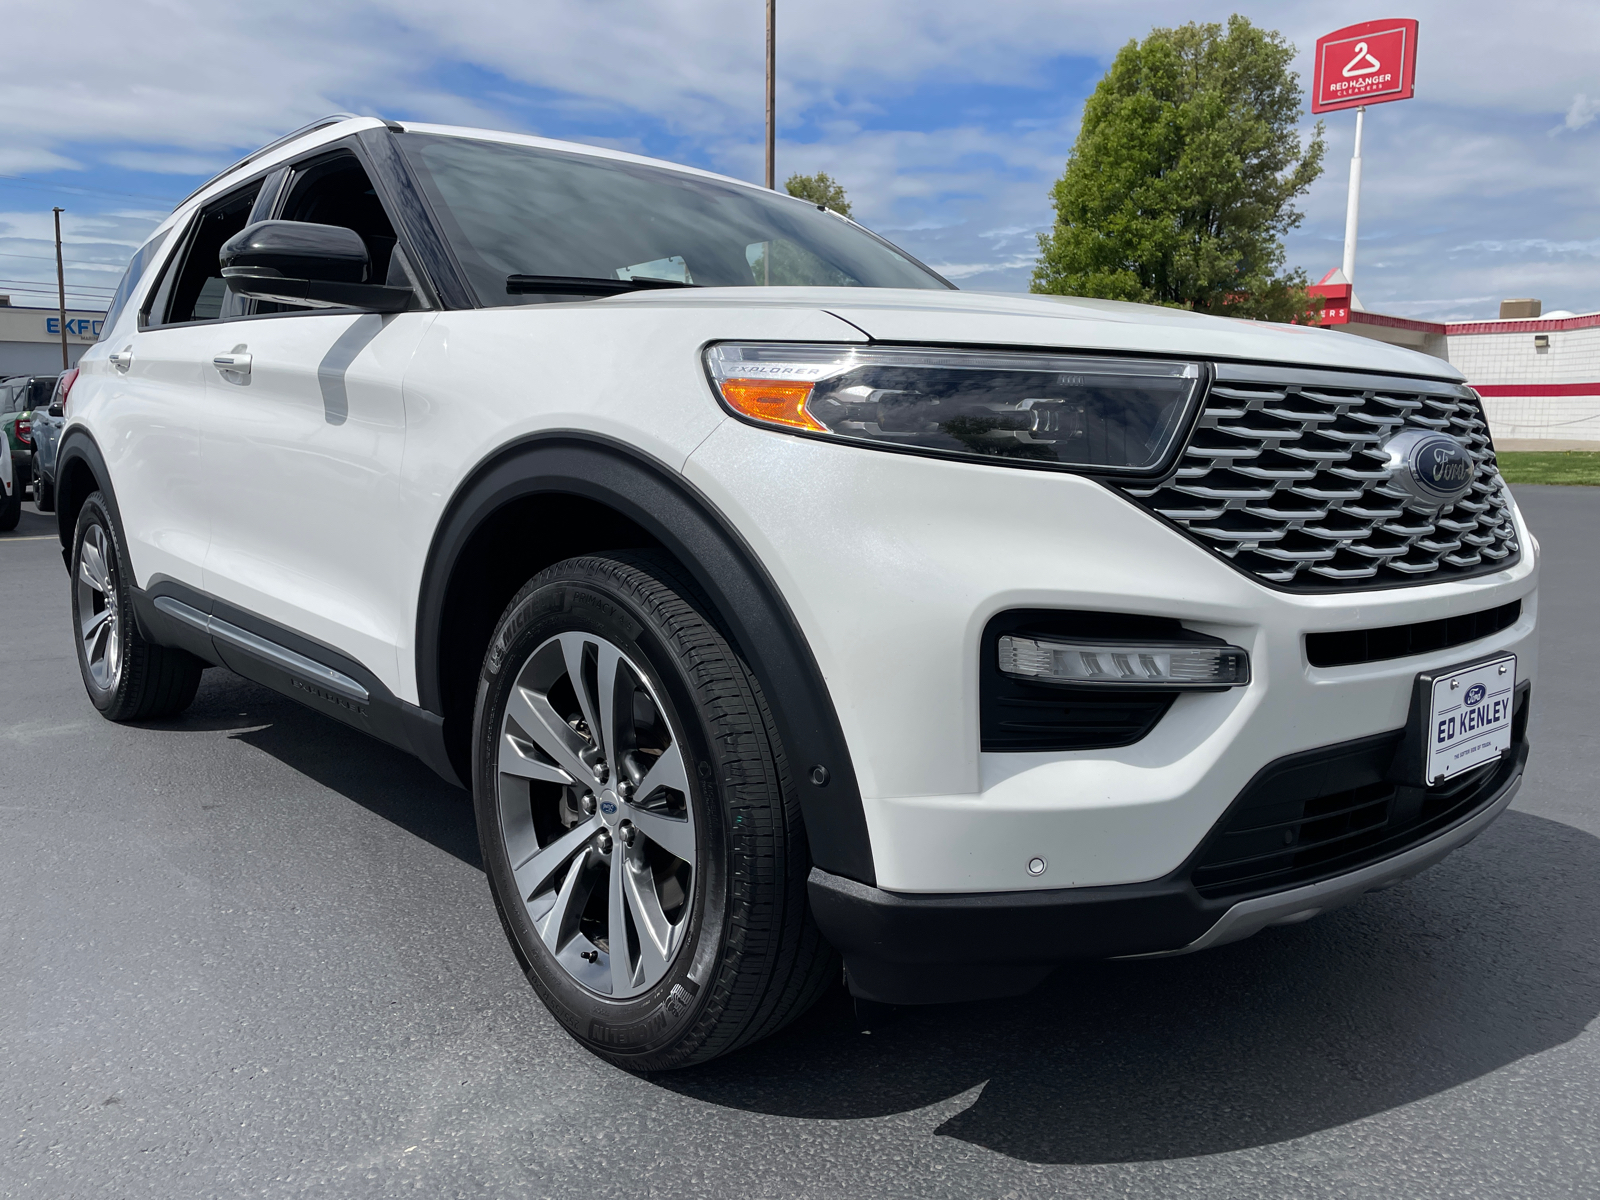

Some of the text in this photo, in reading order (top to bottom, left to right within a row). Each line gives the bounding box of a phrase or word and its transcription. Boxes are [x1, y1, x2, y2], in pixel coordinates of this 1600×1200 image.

[1330, 81, 1348, 91] RED
[1337, 84, 1383, 96] CLEANERS
[728, 366, 820, 375] EXPLORER
[1433, 448, 1467, 482] Ford
[573, 591, 616, 618] PRIMACY
[1437, 697, 1510, 744] ED KENLEY
